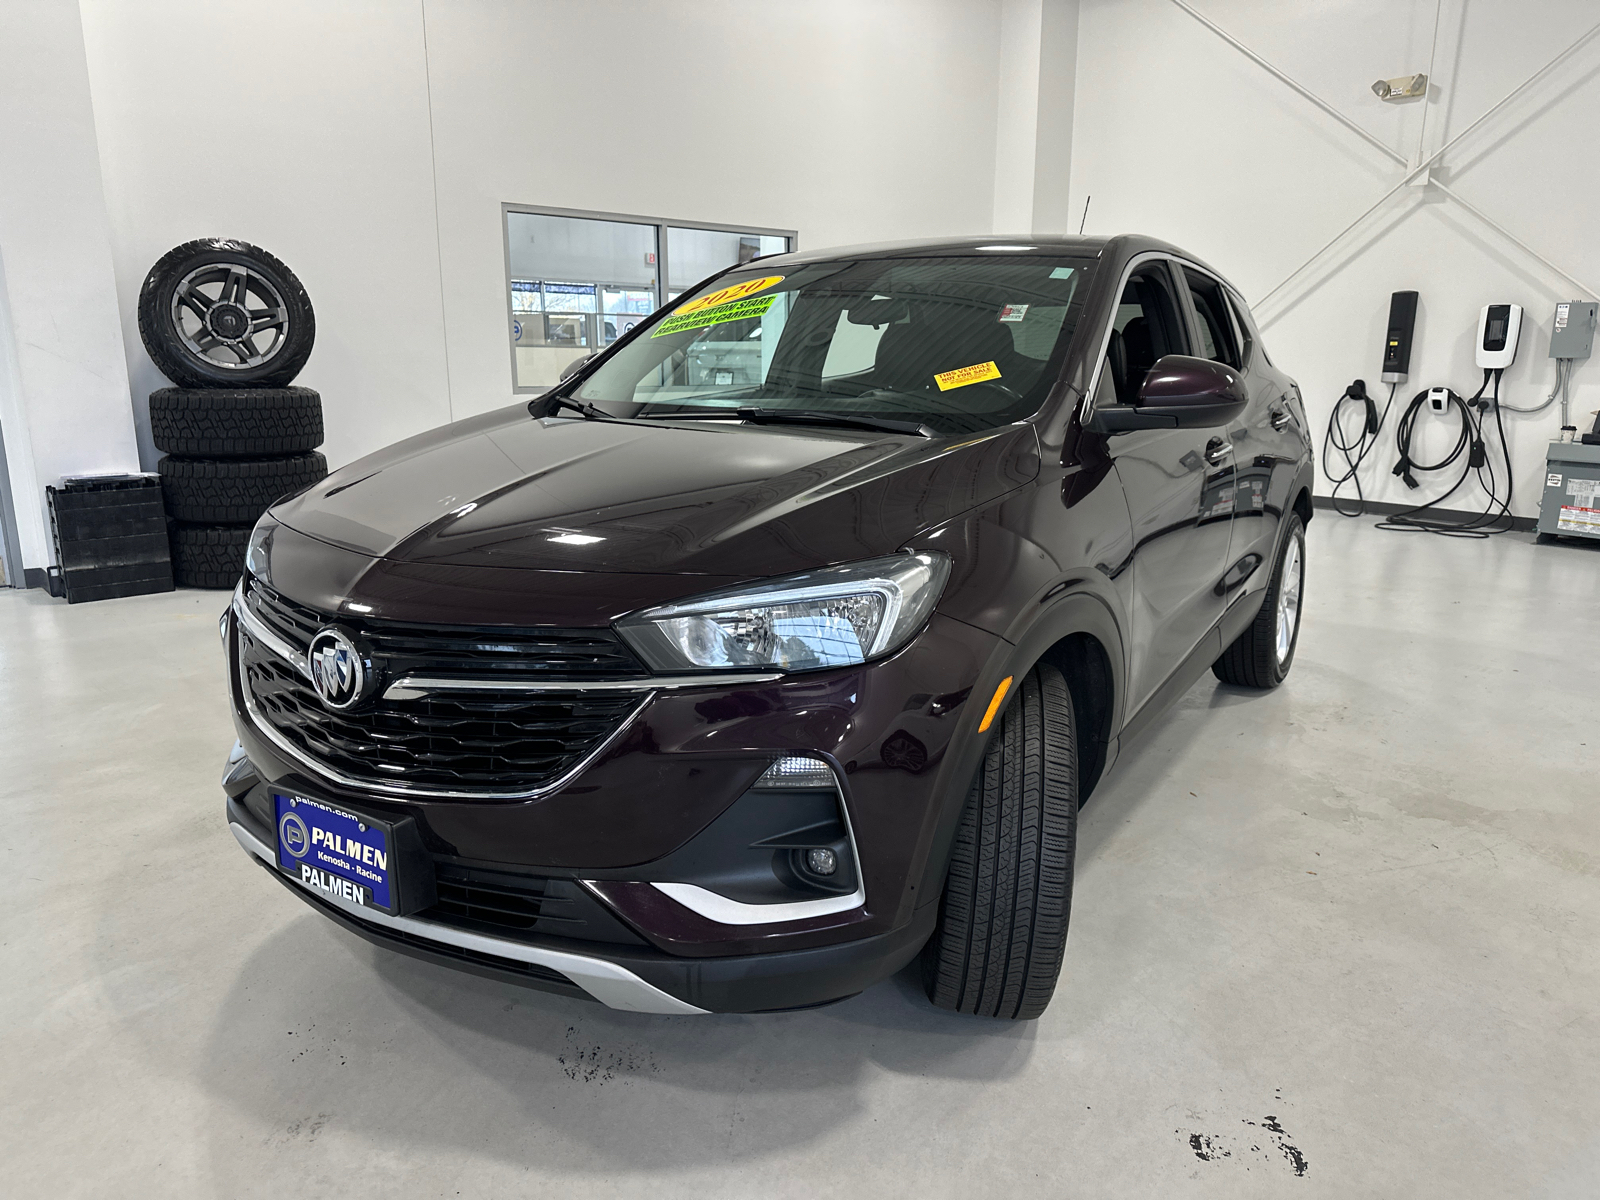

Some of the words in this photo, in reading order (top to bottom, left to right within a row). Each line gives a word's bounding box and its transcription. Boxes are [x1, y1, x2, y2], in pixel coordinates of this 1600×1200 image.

[663, 313, 693, 326] PUSH
[693, 303, 736, 319] BUTTON
[736, 296, 775, 309] START
[687, 279, 766, 312] 2020
[654, 317, 716, 336] REARVIEW
[715, 306, 769, 322] CAMERA
[958, 363, 992, 374] VEHICLE
[295, 796, 358, 822] palmen.com
[312, 827, 387, 871] PALMEN
[318, 851, 350, 870] Kenosha
[356, 866, 382, 883] Racine
[301, 864, 364, 905] PALMEN
